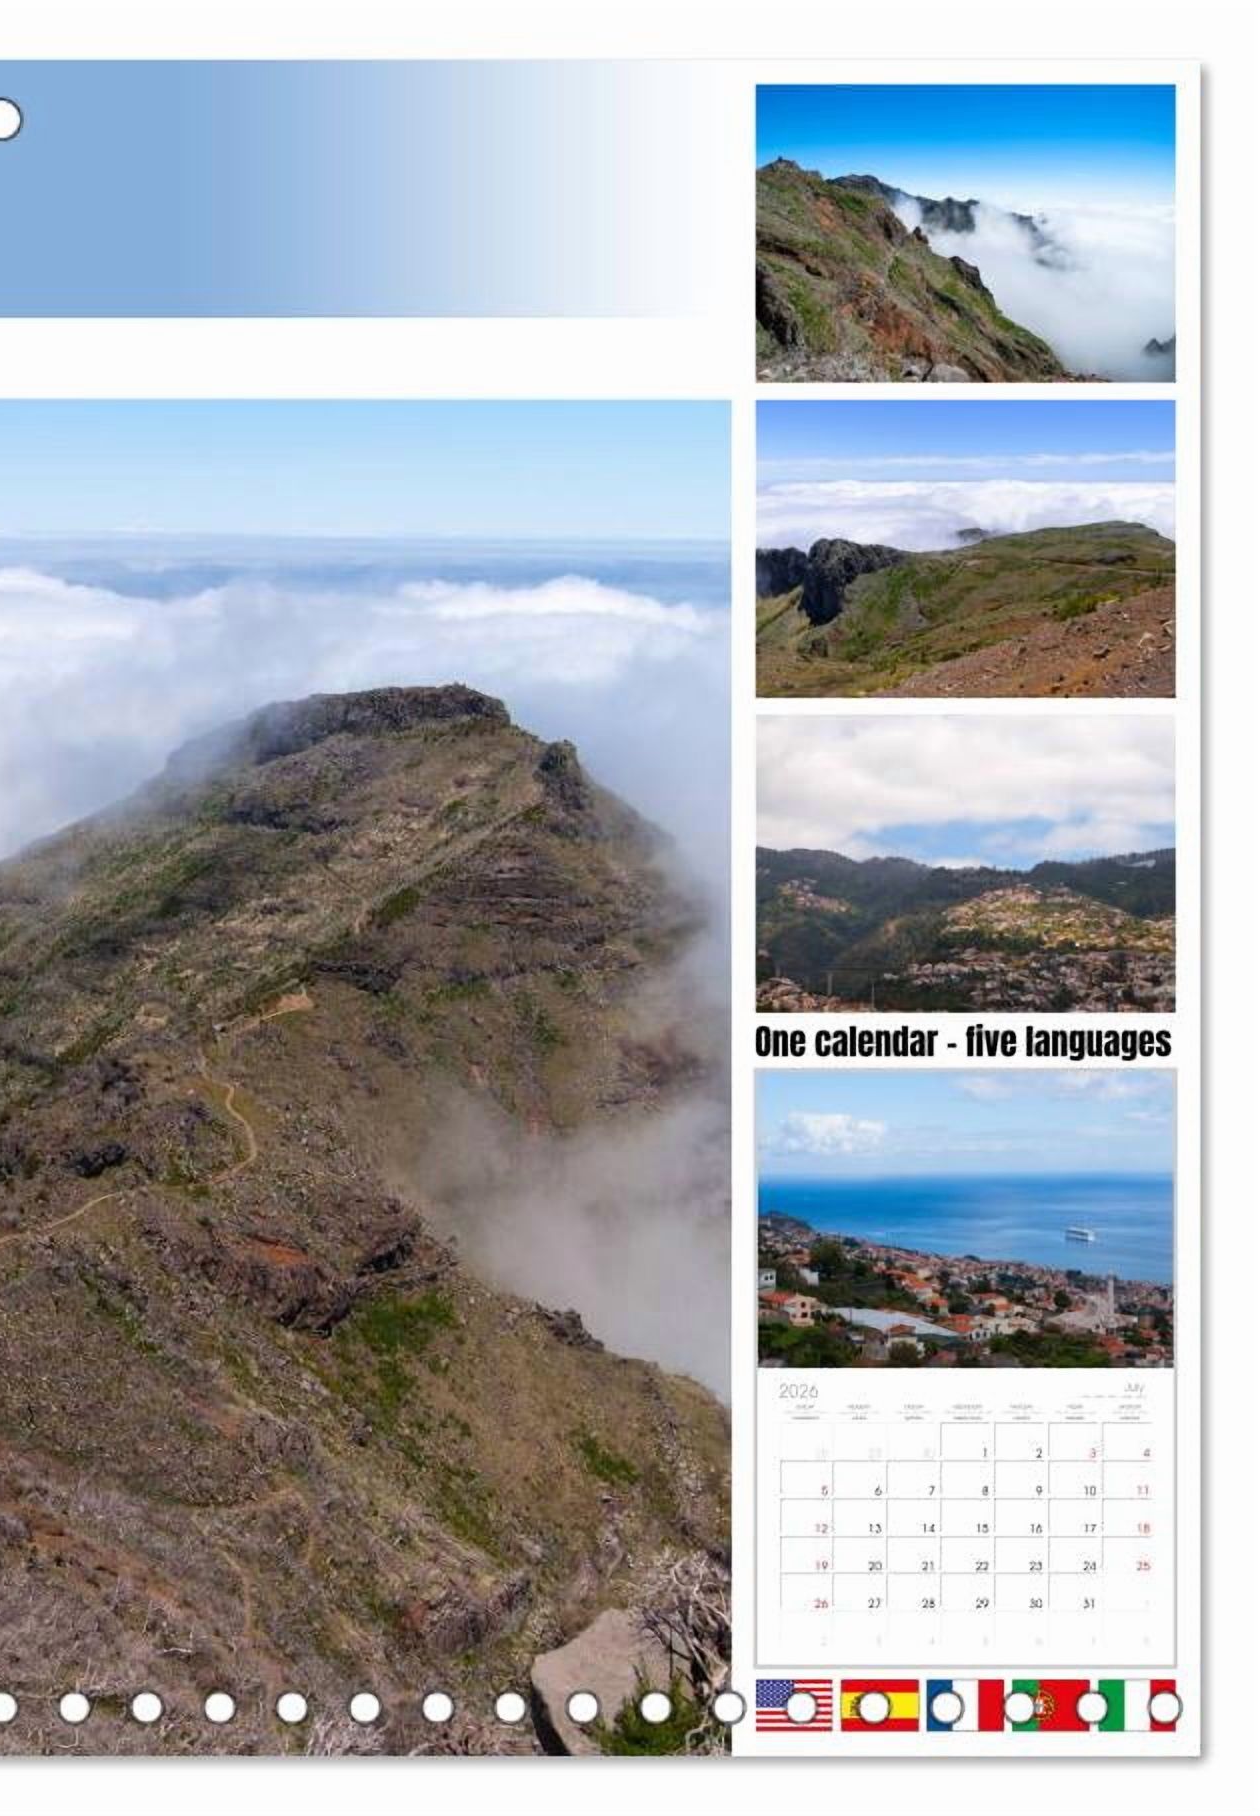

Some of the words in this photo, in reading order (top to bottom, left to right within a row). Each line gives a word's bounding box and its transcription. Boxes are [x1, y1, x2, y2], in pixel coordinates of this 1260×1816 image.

[755, 1025, 806, 1057] One
[814, 1025, 939, 1057] calendar
[965, 1024, 1017, 1057] five
[1025, 1025, 1172, 1061] languages
[779, 1383, 819, 1399] 2026
[1124, 1382, 1145, 1394] July
[1083, 1485, 1097, 1496] 10
[1137, 1485, 1150, 1496] 11
[815, 1523, 829, 1534] 12
[869, 1523, 883, 1534] 13
[923, 1522, 936, 1534] 14
[976, 1522, 990, 1534] 15
[1030, 1523, 1044, 1534] 16
[1084, 1523, 1098, 1534] 17
[815, 1560, 829, 1571] 19
[868, 1560, 883, 1571] 20
[922, 1560, 935, 1571] 21
[975, 1560, 990, 1571] 22
[1083, 1560, 1097, 1571] 24
[814, 1598, 829, 1609] 26
[867, 1598, 881, 1609] 27
[922, 1598, 936, 1609] 28
[975, 1598, 990, 1609] 29
[1029, 1598, 1044, 1609] 30
[1083, 1598, 1095, 1609] 31
